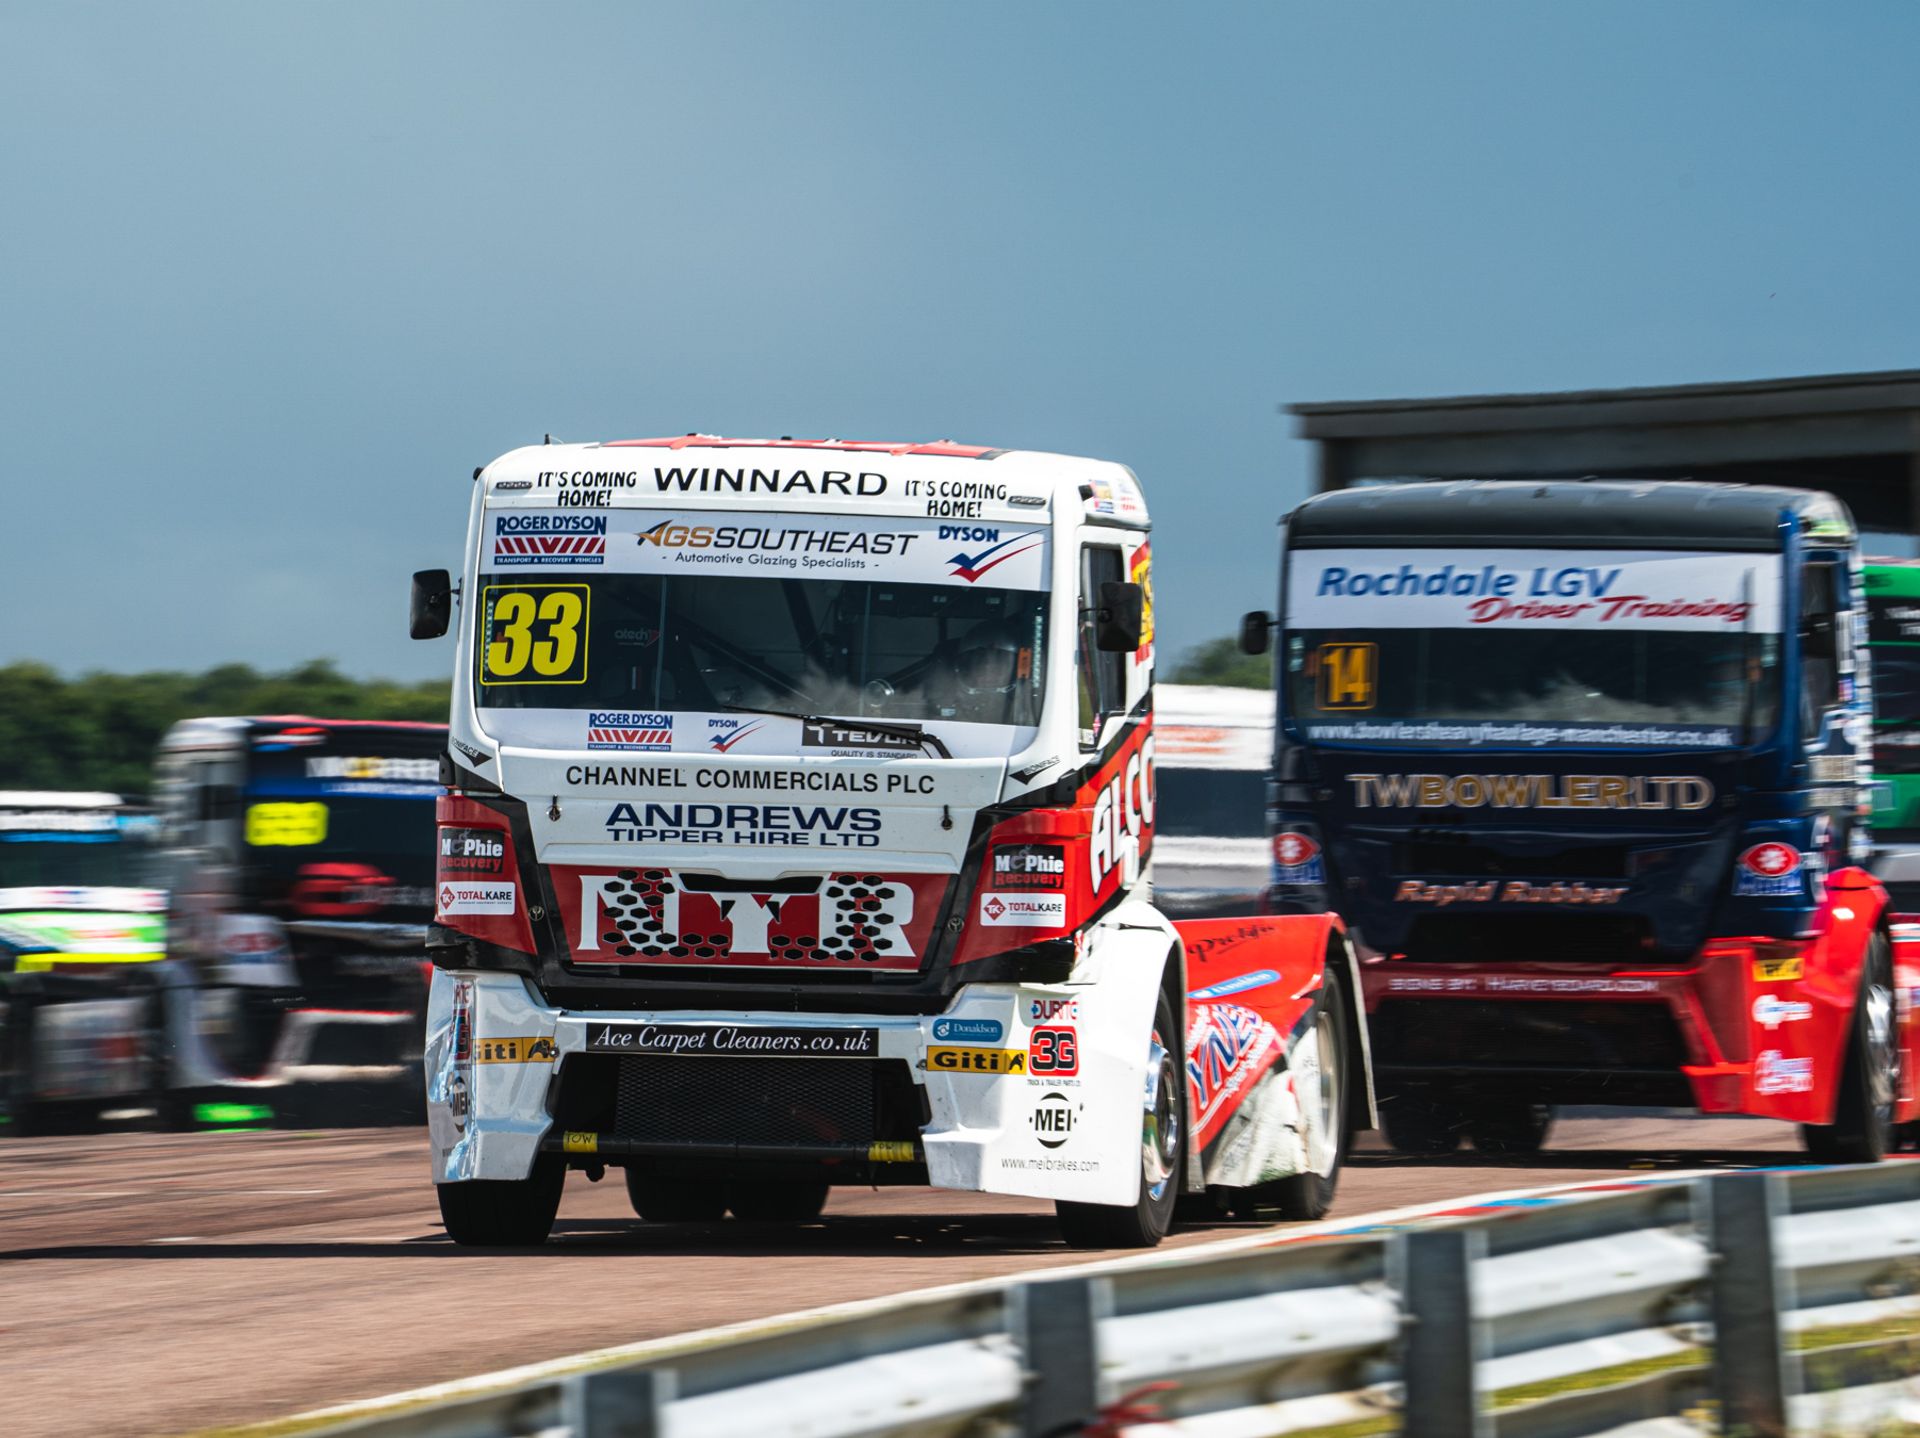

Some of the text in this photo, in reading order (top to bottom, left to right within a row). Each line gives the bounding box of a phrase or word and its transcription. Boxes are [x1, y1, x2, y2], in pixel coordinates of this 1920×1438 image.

[537, 471, 637, 488] IT'S COMING
[653, 467, 888, 496] WINNARD
[557, 489, 612, 507] HOME!
[904, 480, 1007, 500] IT'S COMING
[926, 500, 982, 518] HOME!
[496, 516, 607, 535] ROGER DYSON
[938, 525, 1000, 543] DYSON
[674, 552, 866, 569] Automotive Glazing Specialists
[1316, 564, 1623, 599] Rochdale LGV
[1467, 595, 1757, 624] Driver Training
[487, 591, 583, 677] 33
[1322, 646, 1372, 703] 14
[588, 712, 674, 730] ROGER DYSON
[708, 719, 738, 728] DYSON
[831, 750, 864, 758] QUALITY
[566, 765, 935, 794] CHANNEL COMMERCIALS PLC
[605, 803, 882, 832] ANDREWS
[606, 828, 880, 847] TIPPER HIRE LTD
[441, 857, 502, 873] Recovery
[995, 873, 1063, 888] Recovery
[457, 890, 512, 901] TOTALKARE
[1394, 880, 1499, 906] Rapid
[1008, 902, 1062, 912] TOTALKARE
[953, 1022, 998, 1033] Donaldson
[594, 1024, 871, 1053] Ace Carpet Cleaners.co.uk
[1031, 1030, 1076, 1070] 3G
[934, 1051, 999, 1071] Giti
[1034, 1108, 1072, 1131] MEI
[566, 1133, 593, 1145] TOW
[1001, 1156, 1100, 1172] www.meibrakes.com
